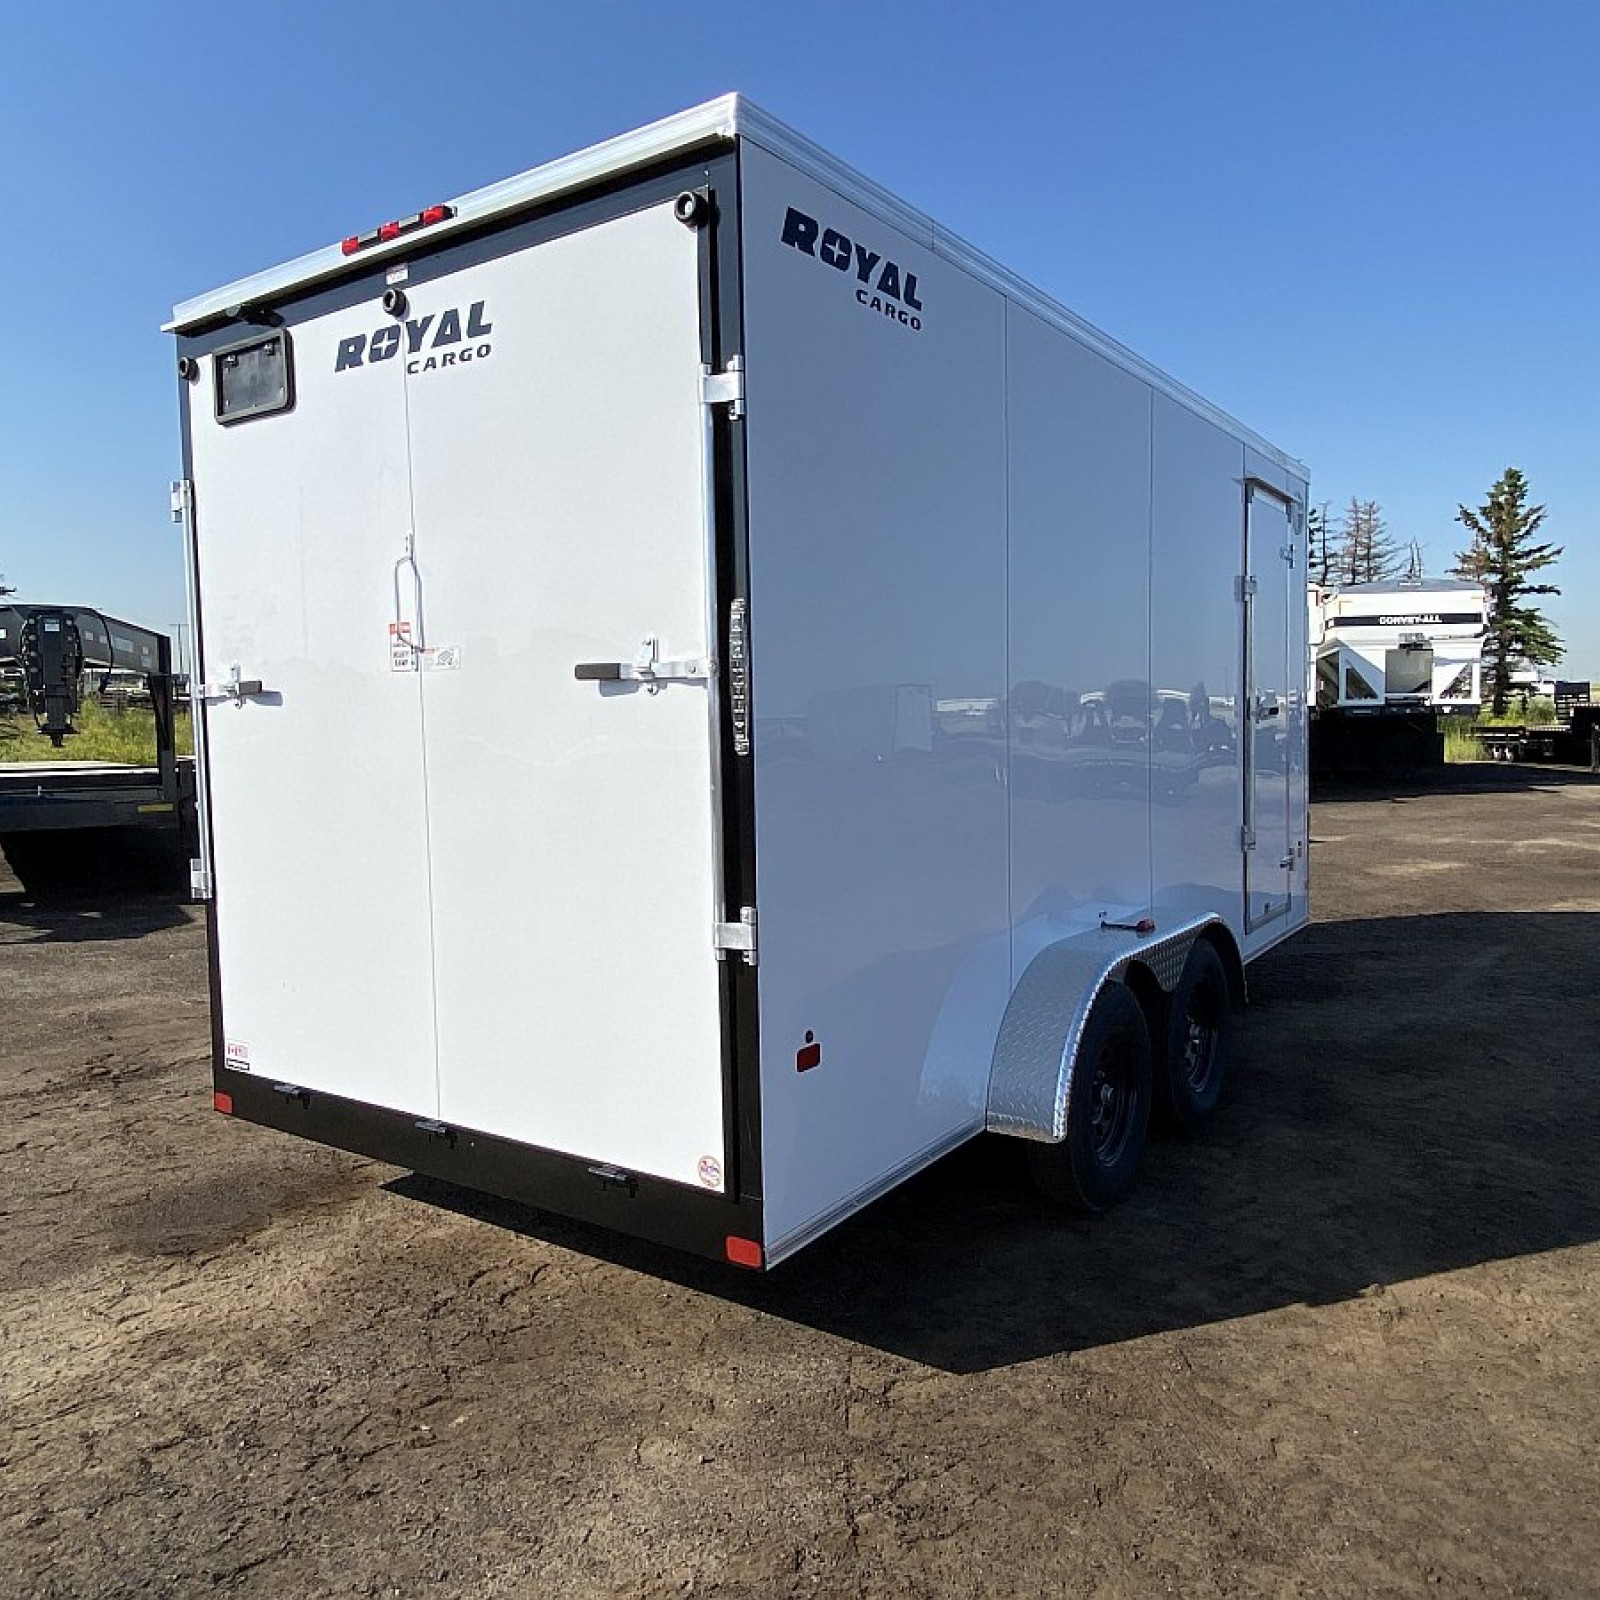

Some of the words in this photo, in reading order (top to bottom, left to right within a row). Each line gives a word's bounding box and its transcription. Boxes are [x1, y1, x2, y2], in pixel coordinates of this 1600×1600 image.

[780, 206, 922, 311] ROYAL
[334, 300, 493, 373] ROYAL
[855, 289, 922, 331] CARGO
[407, 344, 492, 375] CARGO
